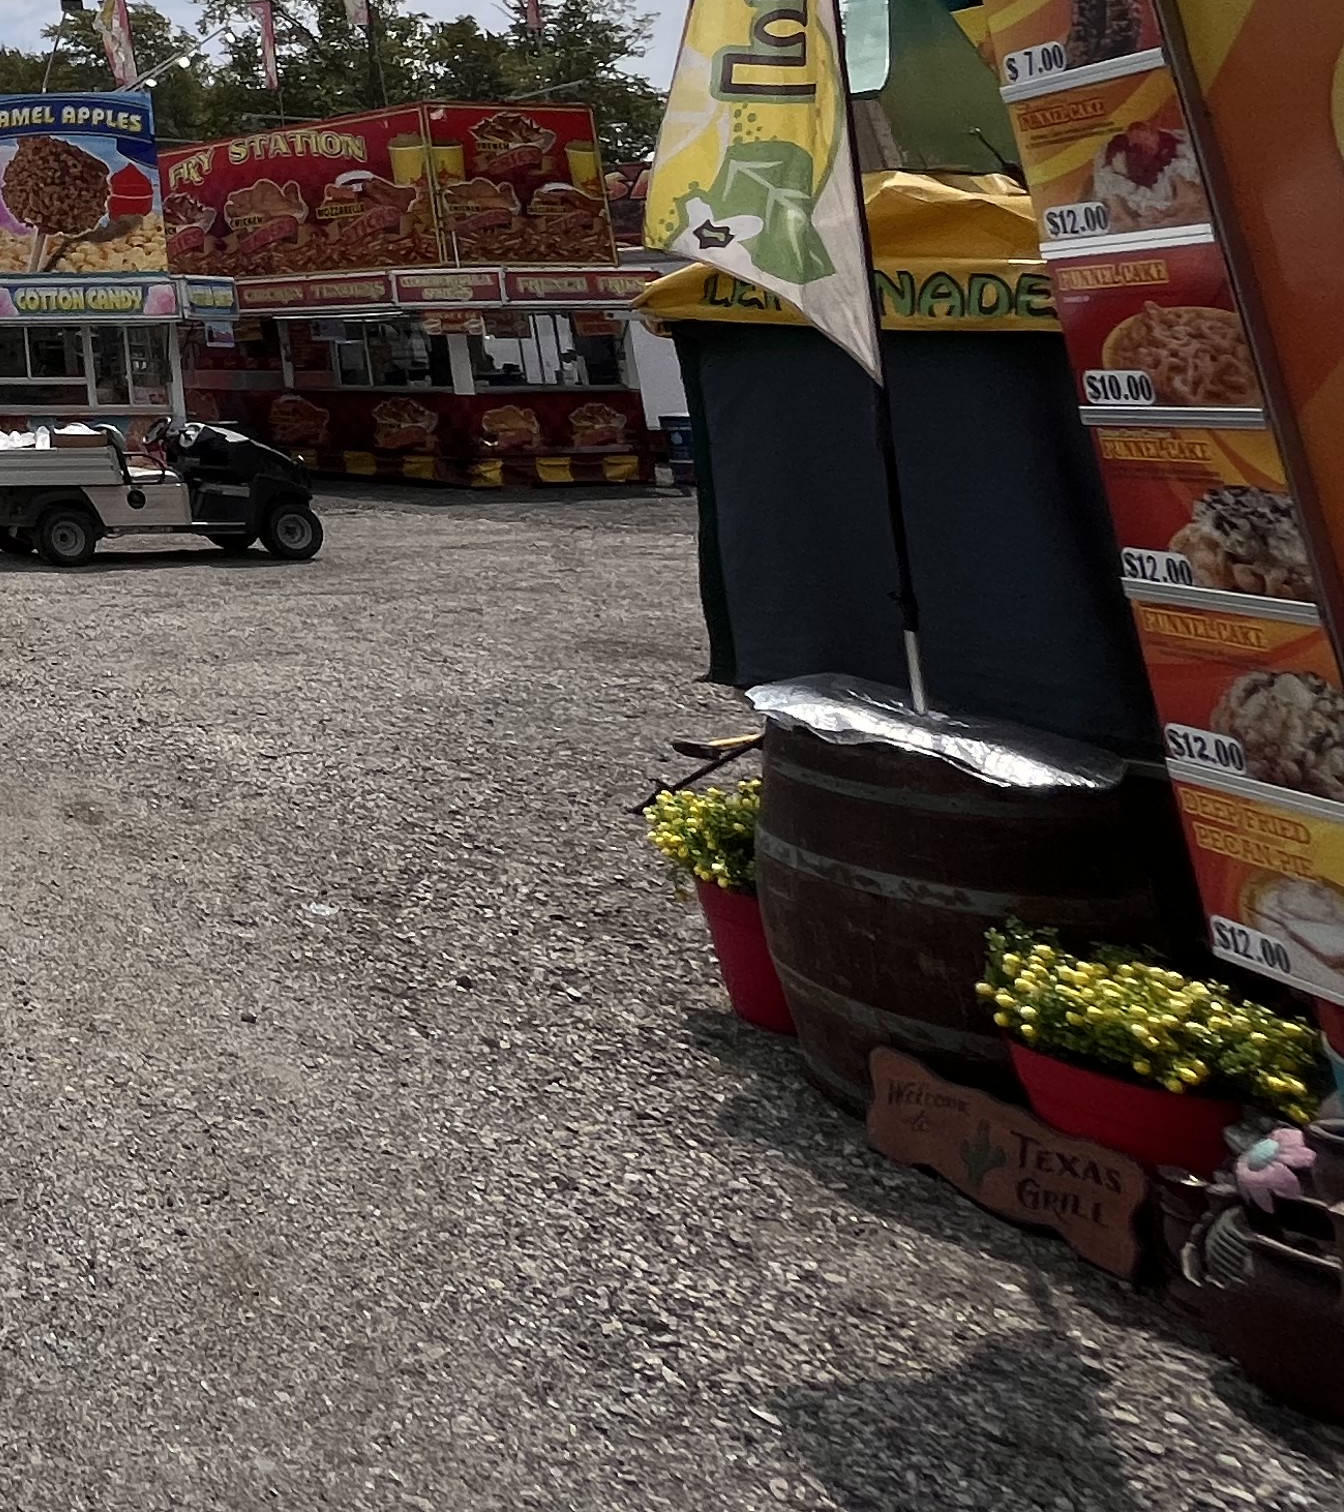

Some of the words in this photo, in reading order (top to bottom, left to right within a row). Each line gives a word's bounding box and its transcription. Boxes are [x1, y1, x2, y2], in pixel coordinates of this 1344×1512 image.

[62, 105, 143, 133] APPLES
[168, 148, 215, 190] FRY
[228, 130, 367, 164] STATION
[1046, 205, 1108, 236] $12.00
[14, 288, 85, 311] COTTON
[85, 287, 143, 310] CANDY
[702, 271, 1058, 319] LENADE
[1086, 374, 1153, 402] $10.00
[1123, 551, 1193, 587] $12.00
[1166, 728, 1245, 771] $12.00
[1177, 787, 1240, 828] DEEP
[1240, 805, 1311, 845] FRIED
[1192, 821, 1275, 868] PECAN
[1274, 849, 1316, 880] PIE
[1214, 920, 1291, 974] $12.00
